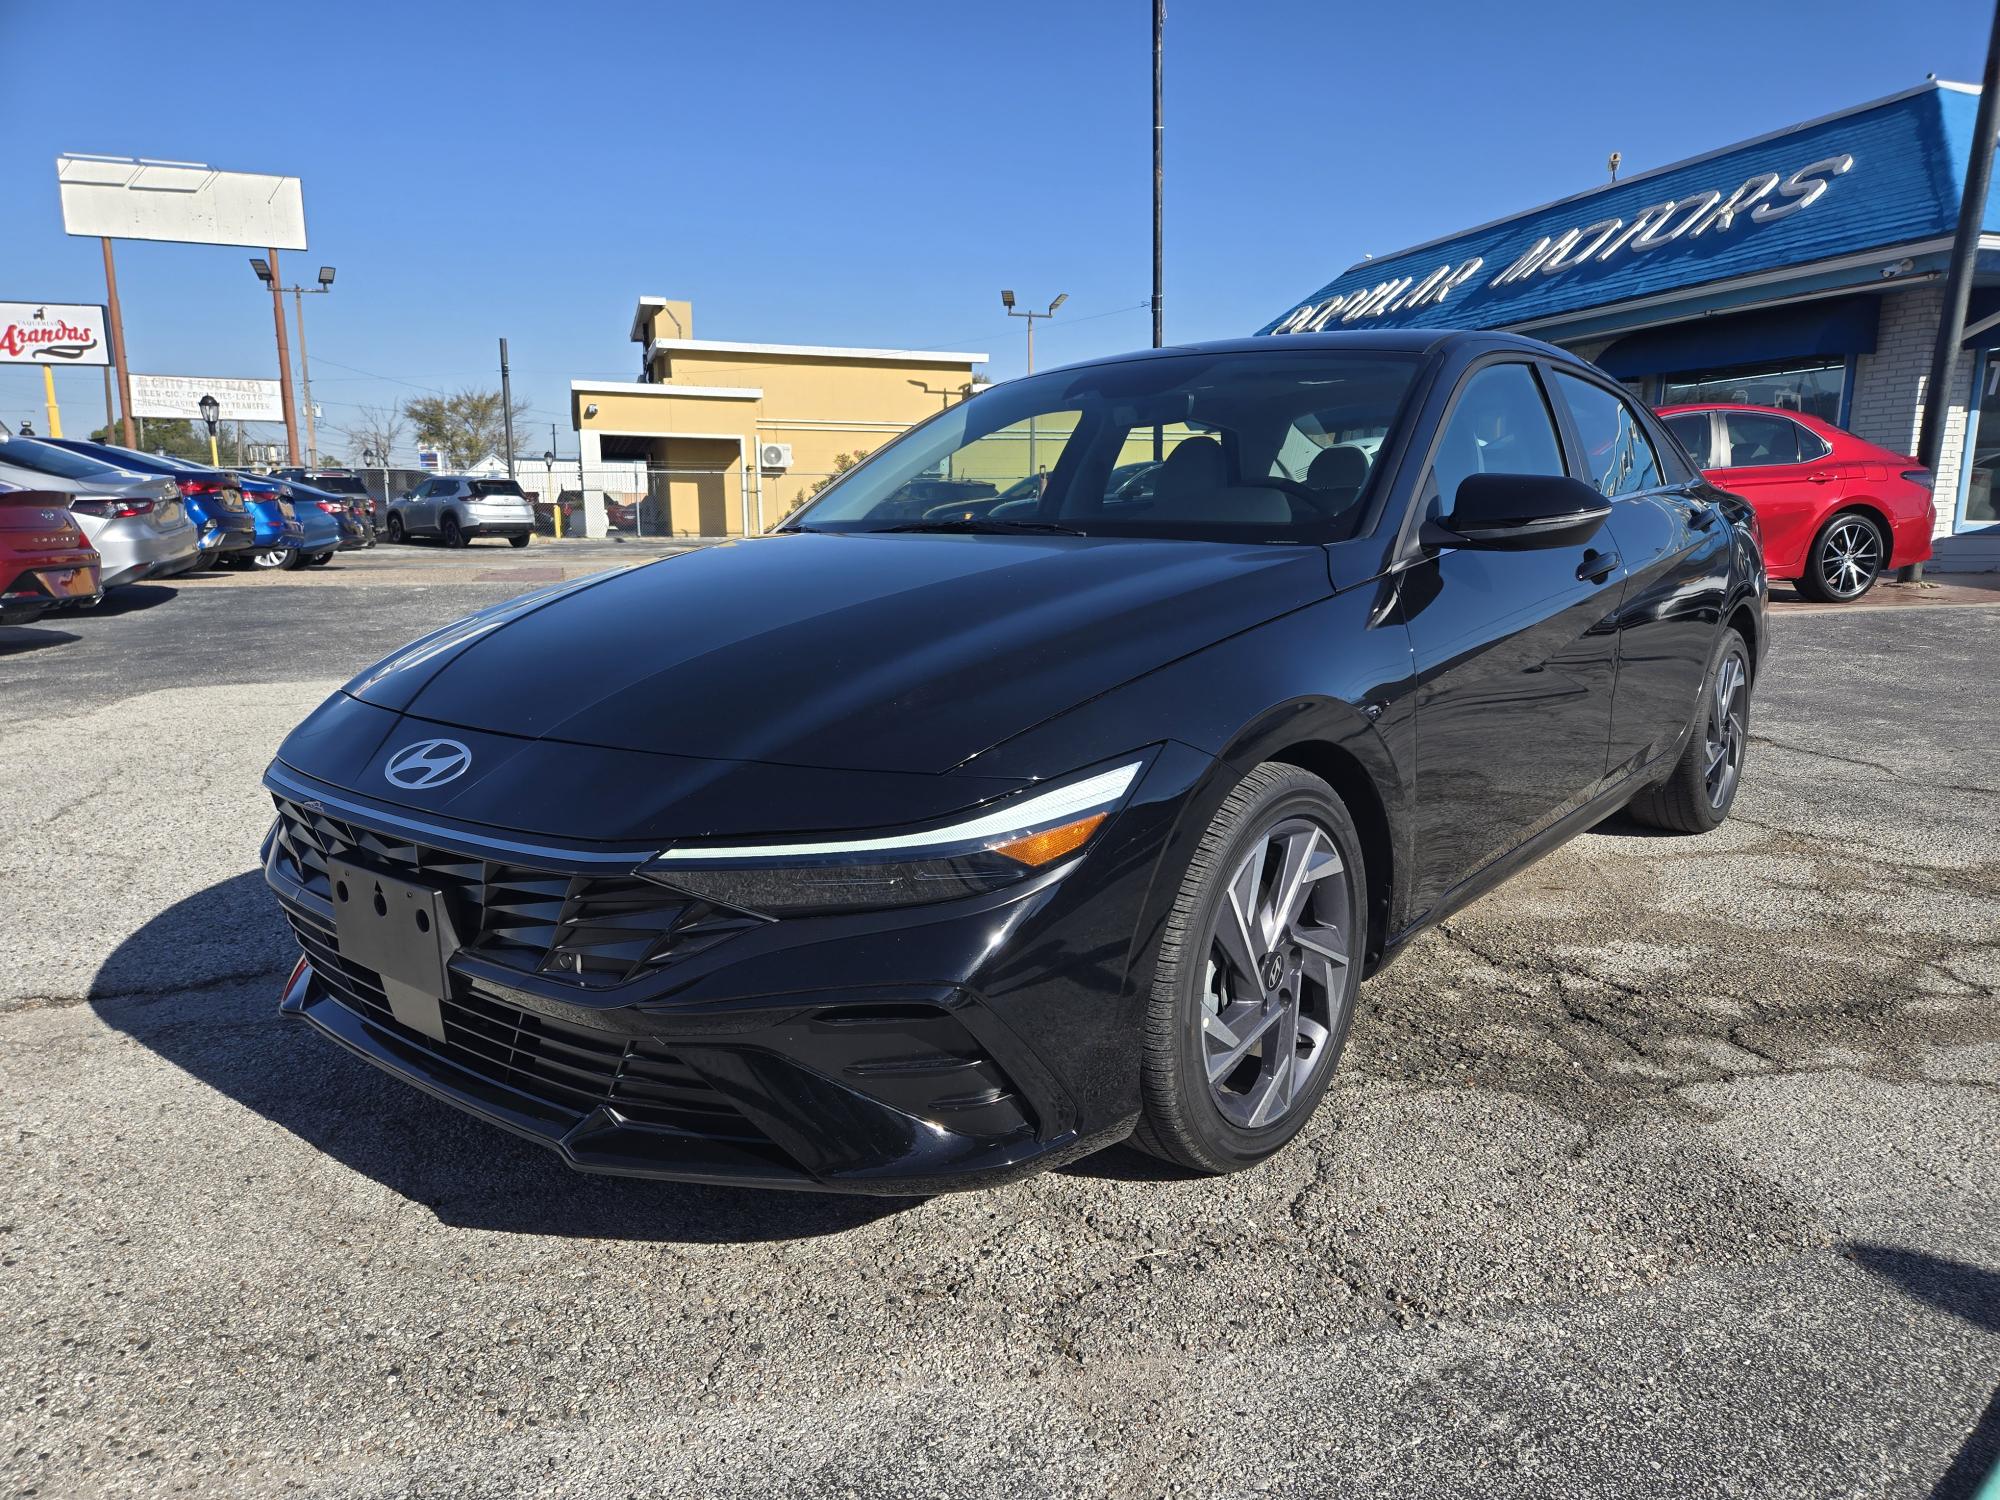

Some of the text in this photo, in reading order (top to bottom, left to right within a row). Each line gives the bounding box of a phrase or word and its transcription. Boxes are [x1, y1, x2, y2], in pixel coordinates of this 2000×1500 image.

[1271, 154, 1854, 336] POPULAR MOTORS
[0, 319, 91, 357] Arandas
